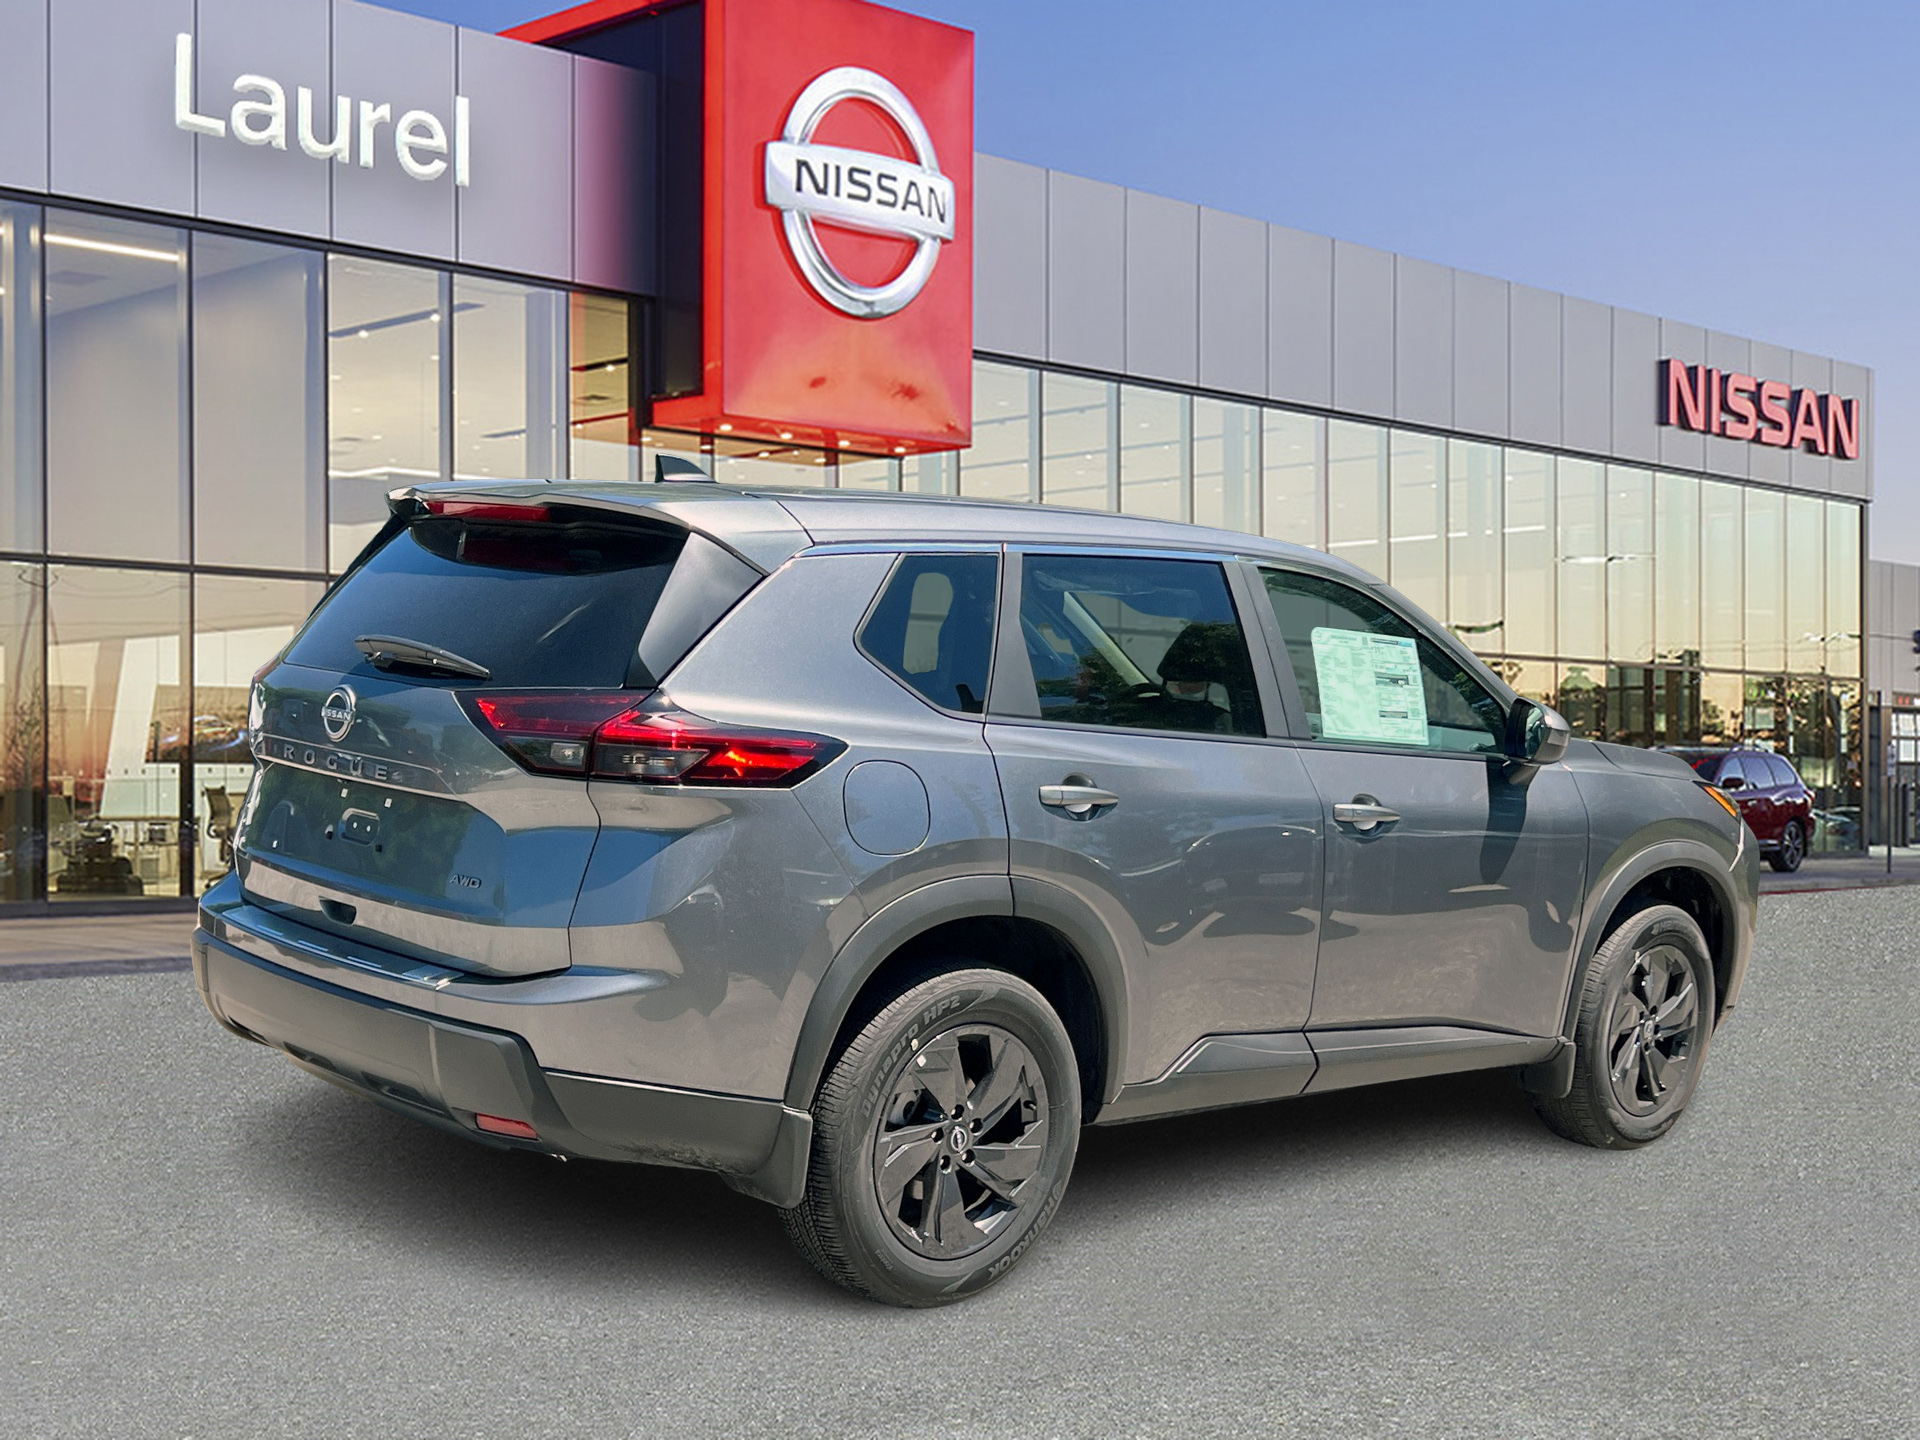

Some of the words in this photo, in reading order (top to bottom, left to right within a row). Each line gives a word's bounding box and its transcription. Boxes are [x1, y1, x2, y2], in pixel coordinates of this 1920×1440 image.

[175, 33, 470, 187] Laurel
[795, 158, 947, 223] NISSAN
[1659, 358, 1860, 460] NISSAN
[283, 743, 388, 781] ROGUE
[449, 874, 482, 889] AWD
[923, 995, 961, 1025] HP2
